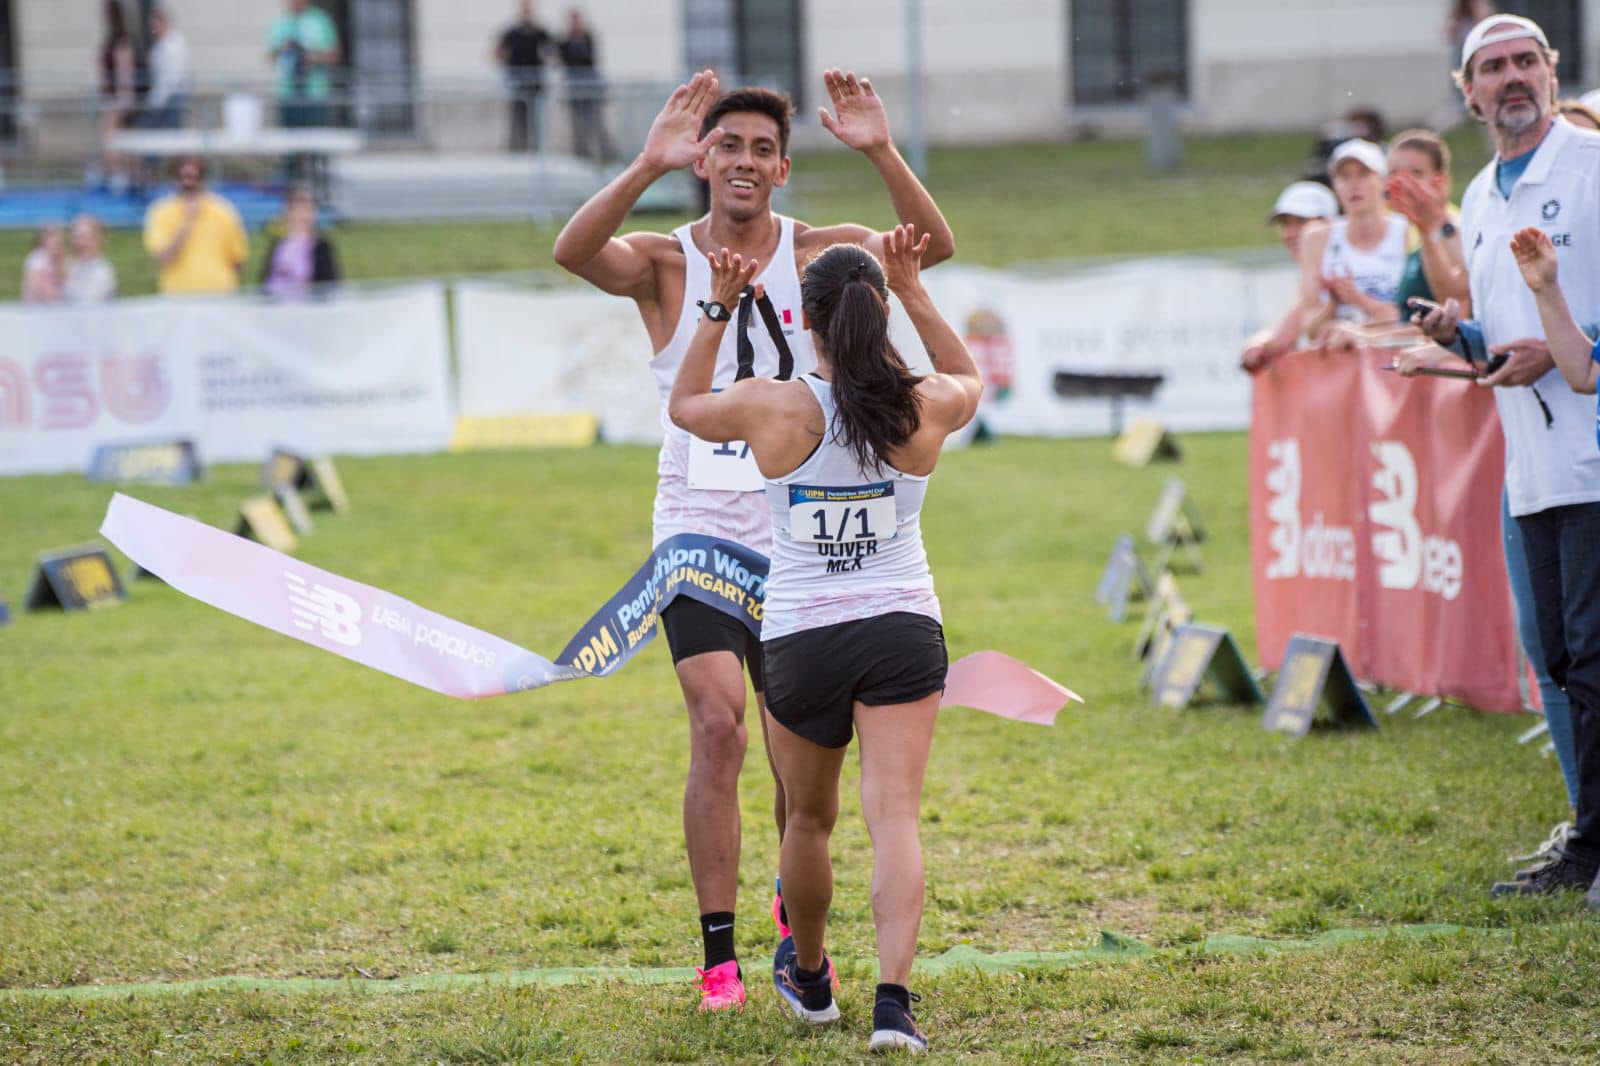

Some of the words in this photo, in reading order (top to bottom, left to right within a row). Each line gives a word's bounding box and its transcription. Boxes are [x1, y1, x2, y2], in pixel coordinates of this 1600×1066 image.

[806, 489, 824, 498] UIPM
[812, 508, 875, 541] 1/1
[827, 558, 862, 572] MEX
[571, 625, 618, 672] IPM
[713, 549, 769, 600] Worl
[666, 567, 747, 606] HUNGARY
[747, 596, 765, 622] 20
